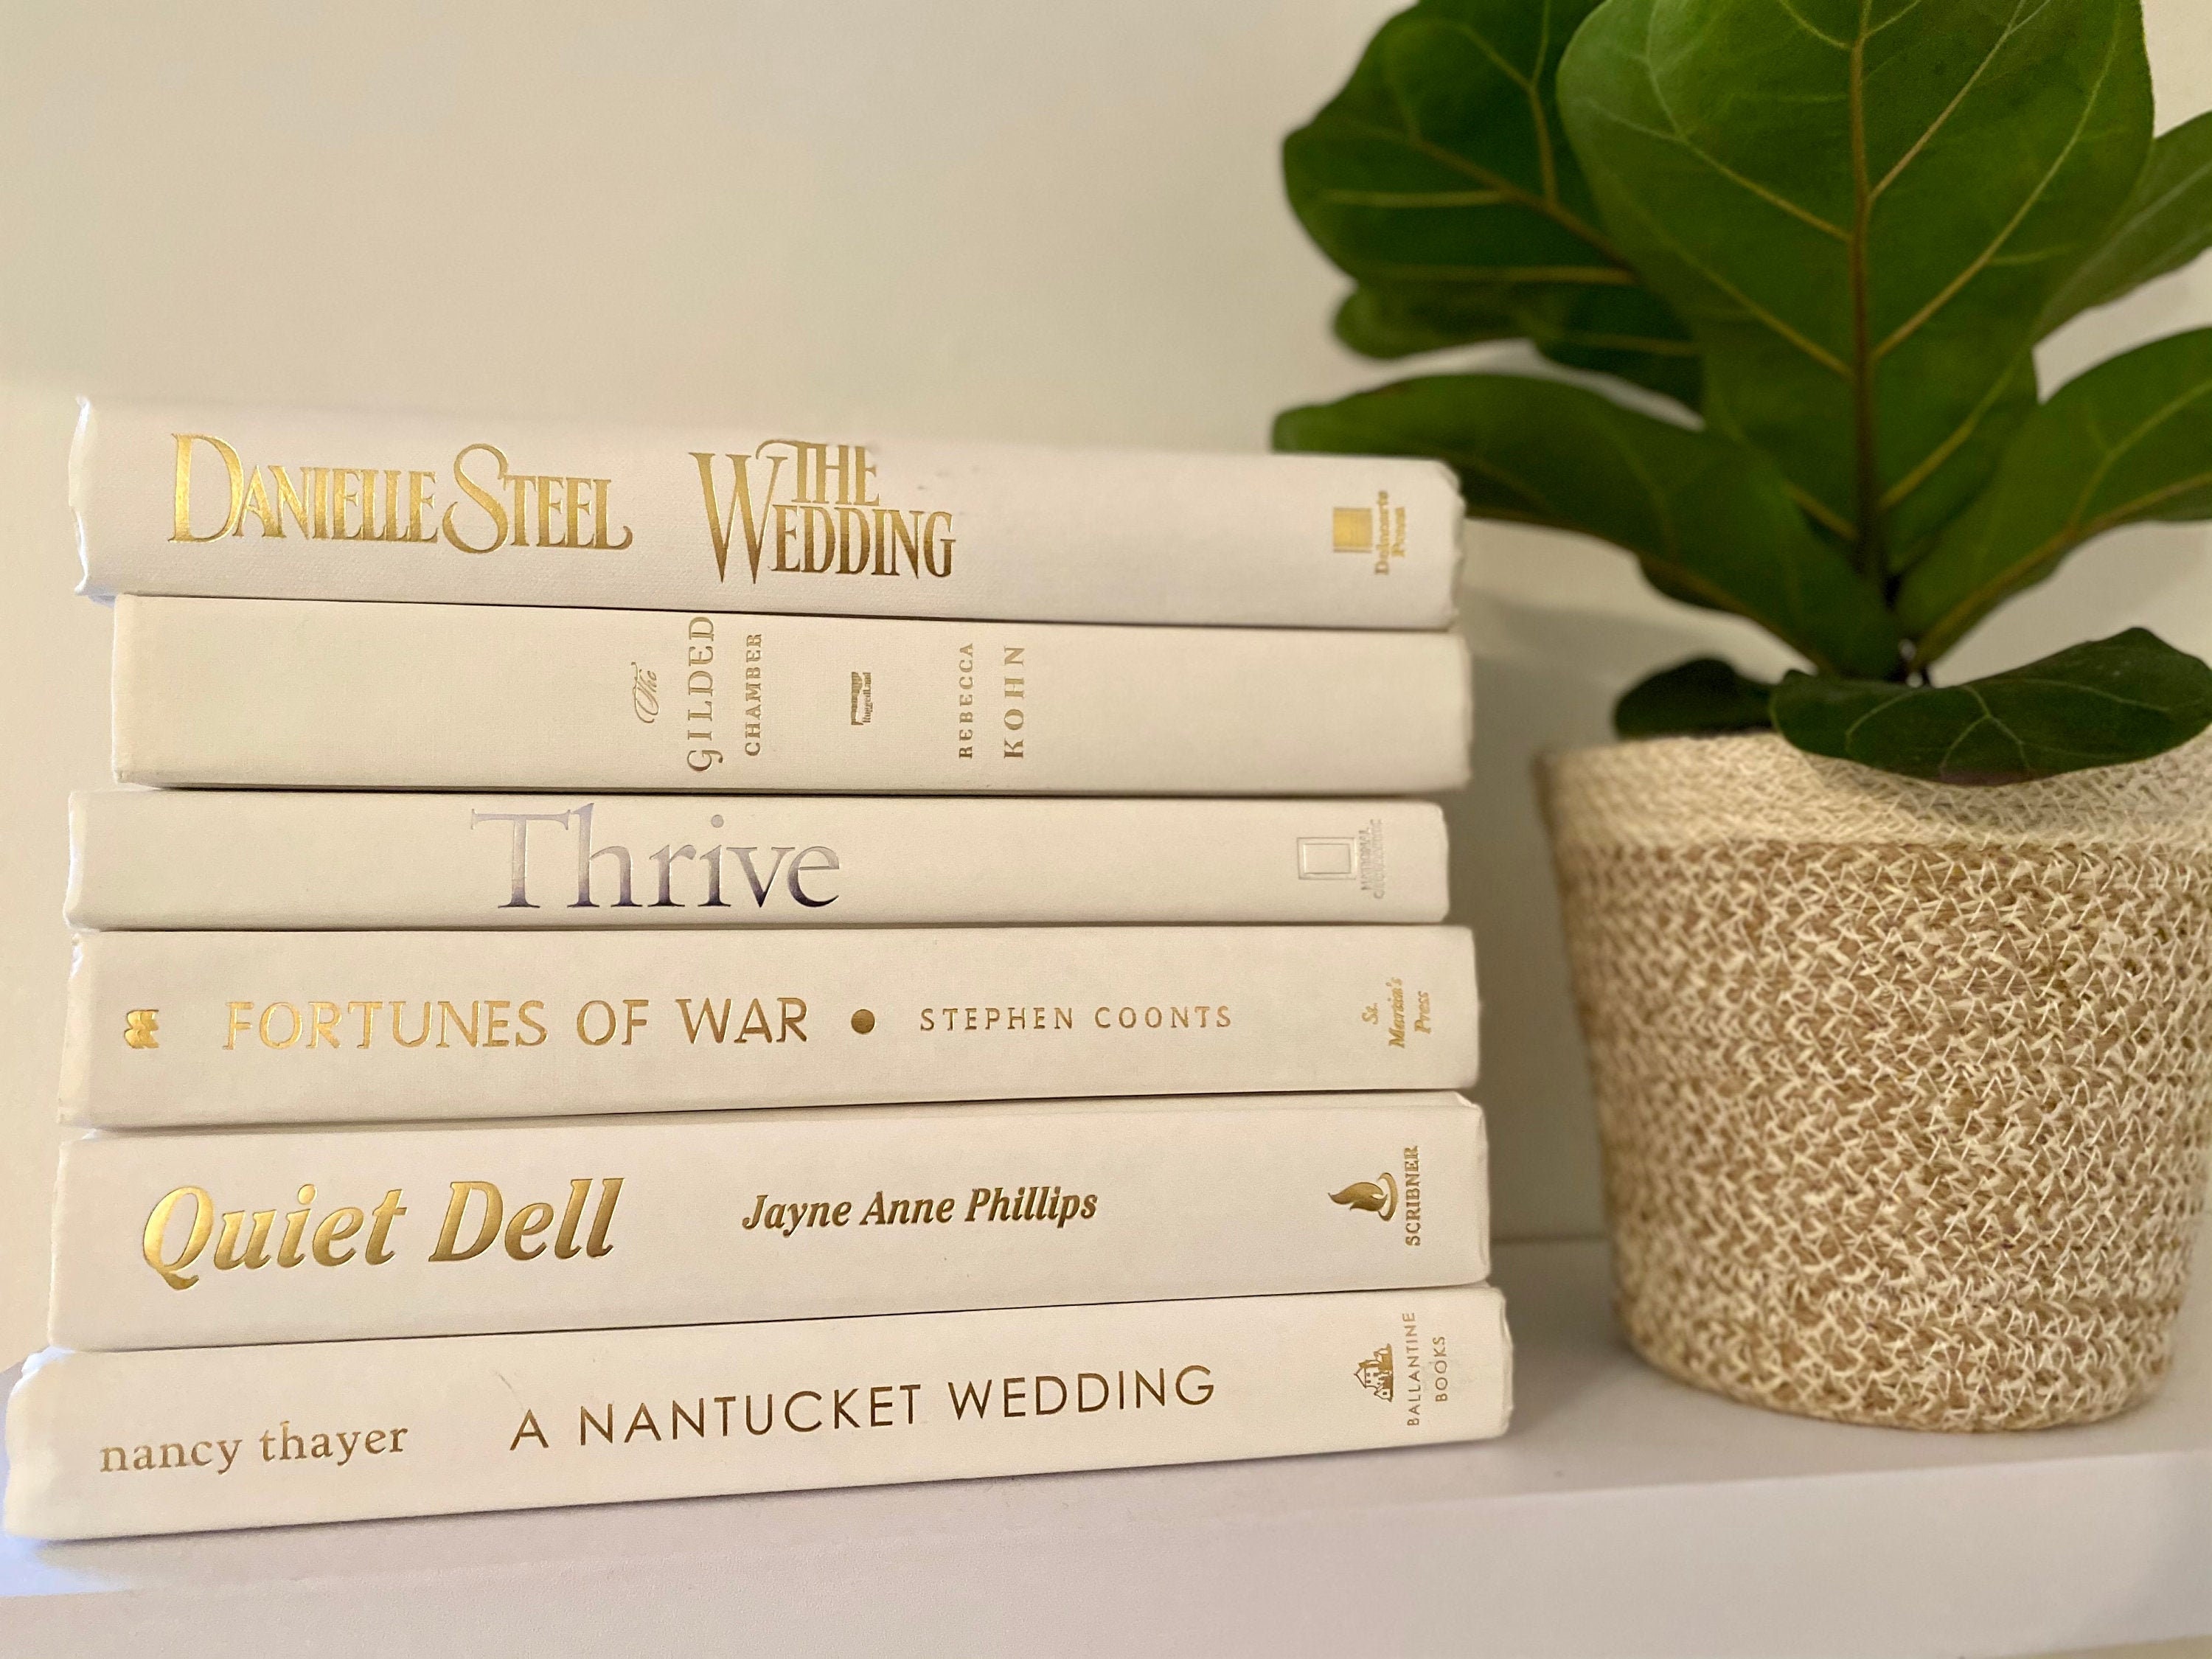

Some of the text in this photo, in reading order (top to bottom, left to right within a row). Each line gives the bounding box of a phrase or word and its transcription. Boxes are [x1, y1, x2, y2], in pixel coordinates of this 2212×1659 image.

[168, 432, 633, 554] DANIELLE STEEL
[688, 451, 956, 585] WEDDING
[755, 439, 880, 507] THE
[630, 661, 660, 724] The
[686, 616, 723, 772] GILDED
[745, 633, 762, 757] CHAMBER
[959, 642, 974, 760] REBECCA
[1004, 646, 1026, 760] KOHN
[470, 802, 841, 909] Thrive
[222, 997, 808, 1050] FORTUNES OF WAR
[920, 1006, 1232, 1032] STEPHEN COONTS
[1414, 990, 1431, 1034] Press
[143, 1178, 626, 1291] Quiet Dell
[742, 1185, 1099, 1238] Jayne Anne Phillips
[1403, 1145, 1422, 1247] SCRIBNER
[509, 1364, 1215, 1451] A NANTUCKET WEDDING
[1402, 1312, 1422, 1427] BALLANTINE
[1432, 1335, 1449, 1402] BOOKS
[100, 1420, 408, 1475] nancy thayer
